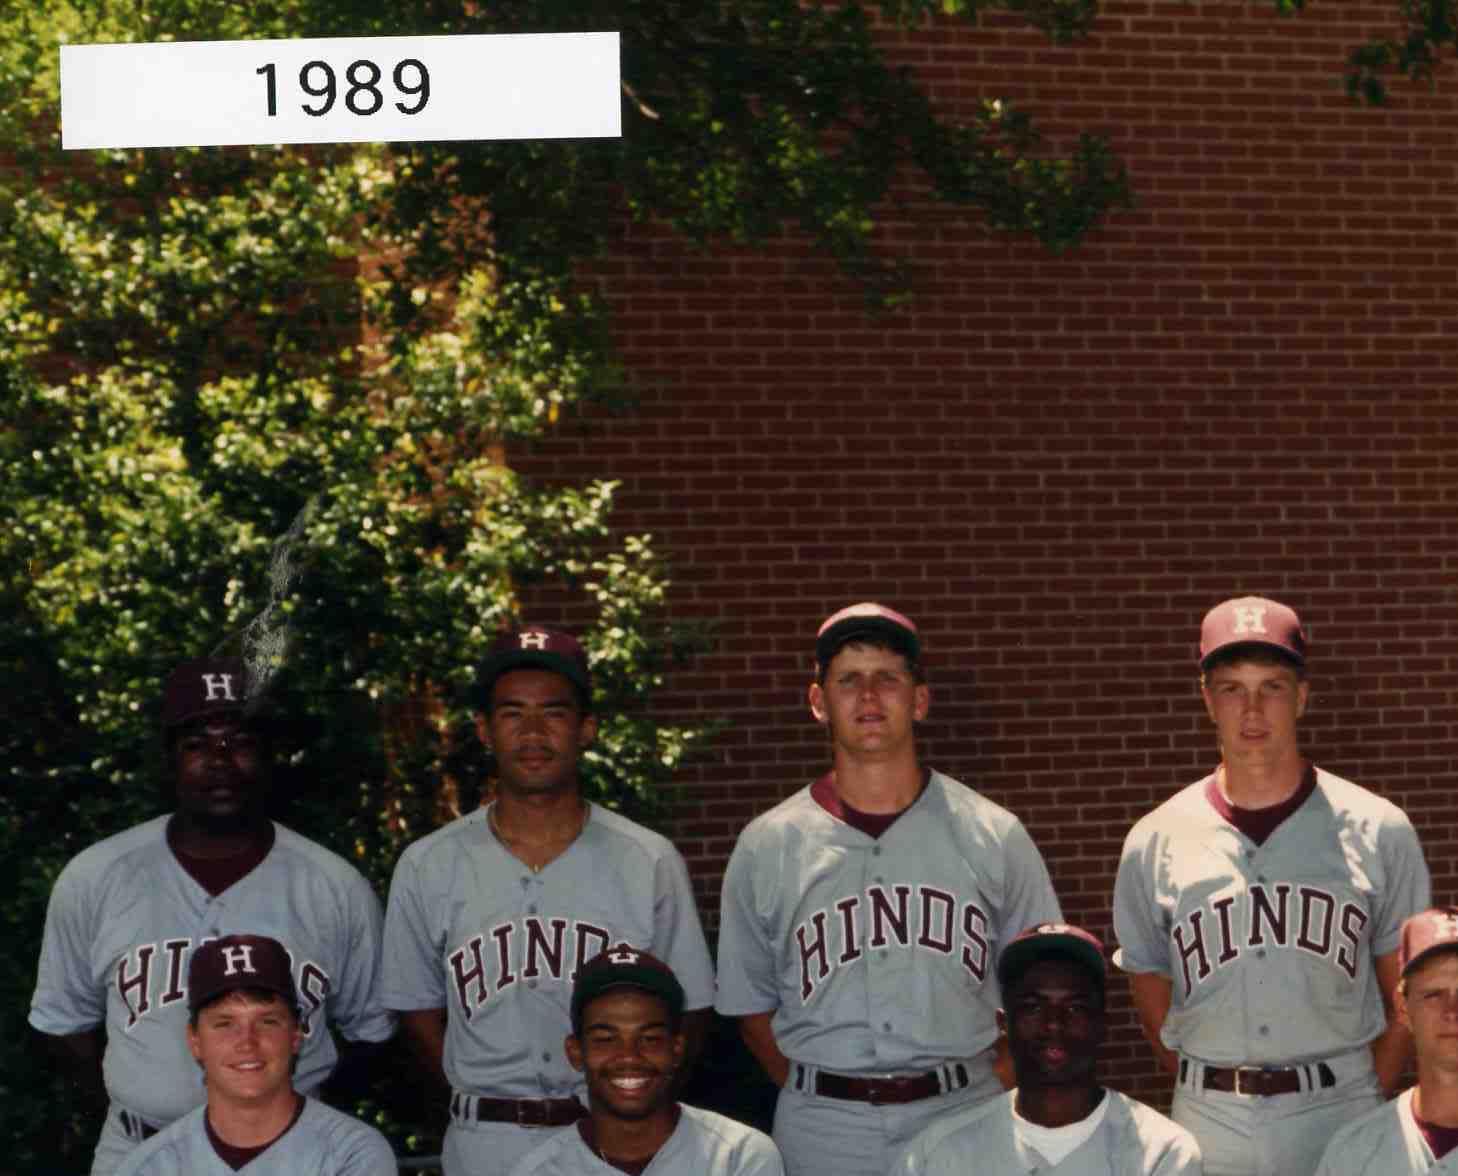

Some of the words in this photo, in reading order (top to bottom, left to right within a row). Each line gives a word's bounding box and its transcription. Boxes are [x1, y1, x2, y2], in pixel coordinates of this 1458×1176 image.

[518, 631, 550, 653] H
[1231, 603, 1269, 635] H
[201, 672, 237, 701] H
[222, 944, 257, 976] H
[447, 916, 636, 1022] HIND
[795, 884, 991, 1006] HINDS
[1172, 883, 1370, 1002] HINDS
[116, 937, 332, 1038] HIS
